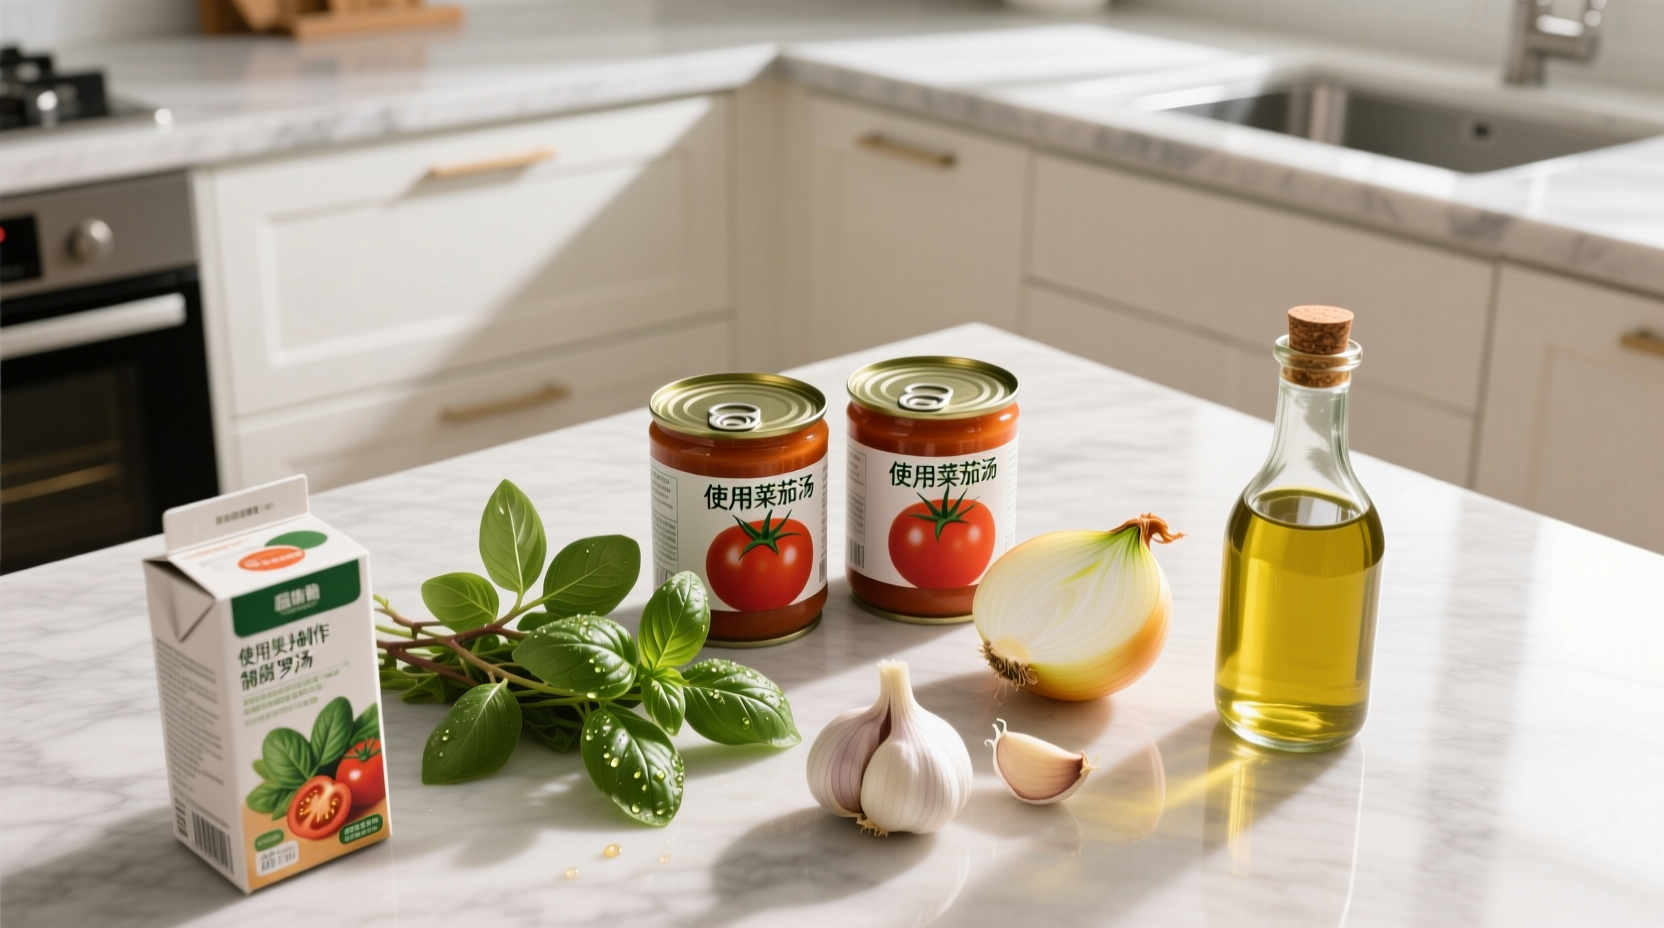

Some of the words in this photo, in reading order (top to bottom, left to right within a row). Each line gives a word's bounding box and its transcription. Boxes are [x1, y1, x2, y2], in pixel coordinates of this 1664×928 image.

[888, 457, 997, 489] 使用菜茄汤
[704, 474, 814, 511] 使用菜茄汤
